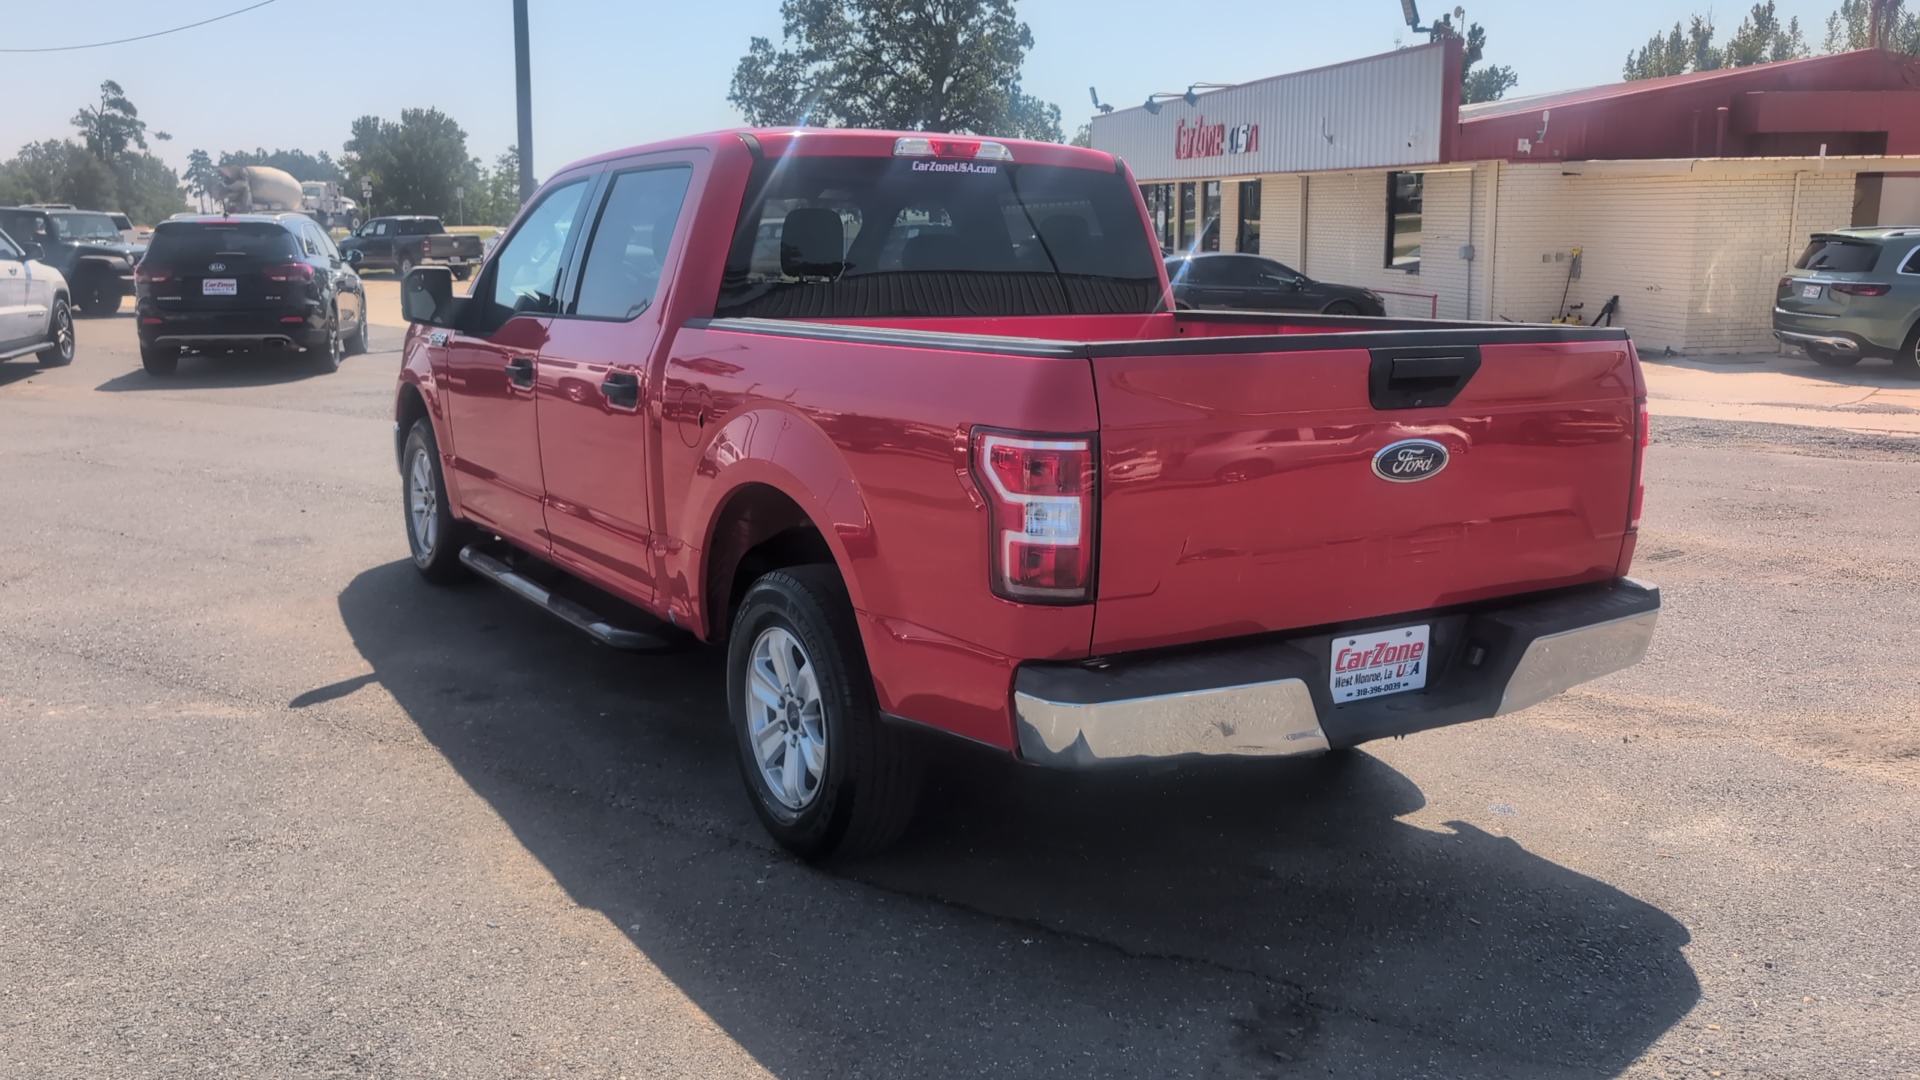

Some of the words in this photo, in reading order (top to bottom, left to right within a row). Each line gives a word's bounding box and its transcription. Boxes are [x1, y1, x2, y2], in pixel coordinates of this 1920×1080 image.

[1175, 115, 1225, 159] CarZone
[1229, 124, 1258, 154] USA
[912, 161, 997, 174] CarZoneUSA.com
[1392, 448, 1435, 474] Ford
[1335, 641, 1425, 674] CarZone
[1335, 676, 1353, 689] West
[1354, 671, 1383, 686] Monroe,
[1384, 668, 1393, 680] La
